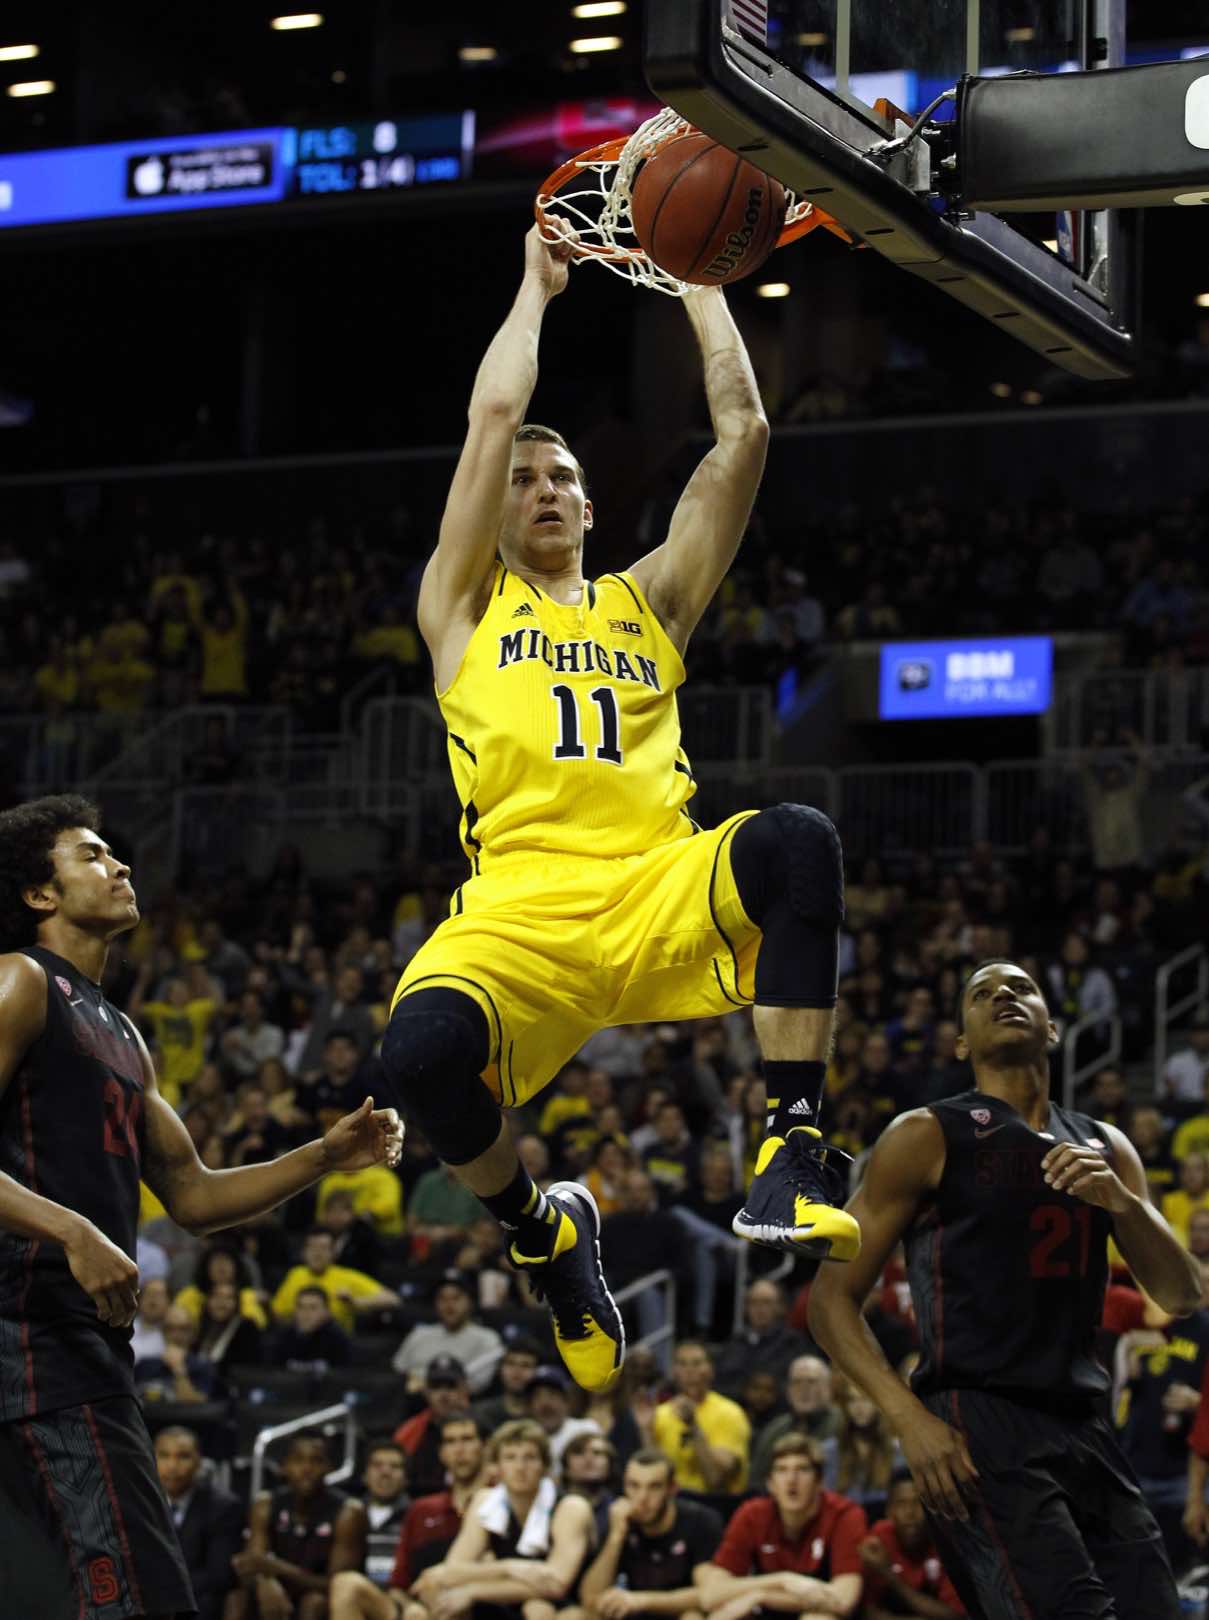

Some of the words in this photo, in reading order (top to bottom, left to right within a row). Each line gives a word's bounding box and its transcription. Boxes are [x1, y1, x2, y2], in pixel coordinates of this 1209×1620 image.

[168, 169, 207, 194] App
[211, 163, 265, 188] Store
[702, 188, 763, 278] Wilson
[497, 628, 662, 692] MICHIGAN
[946, 651, 1014, 681] BBM
[551, 683, 624, 767] 11
[1029, 1203, 1090, 1279] 21
[89, 1556, 119, 1605] S
